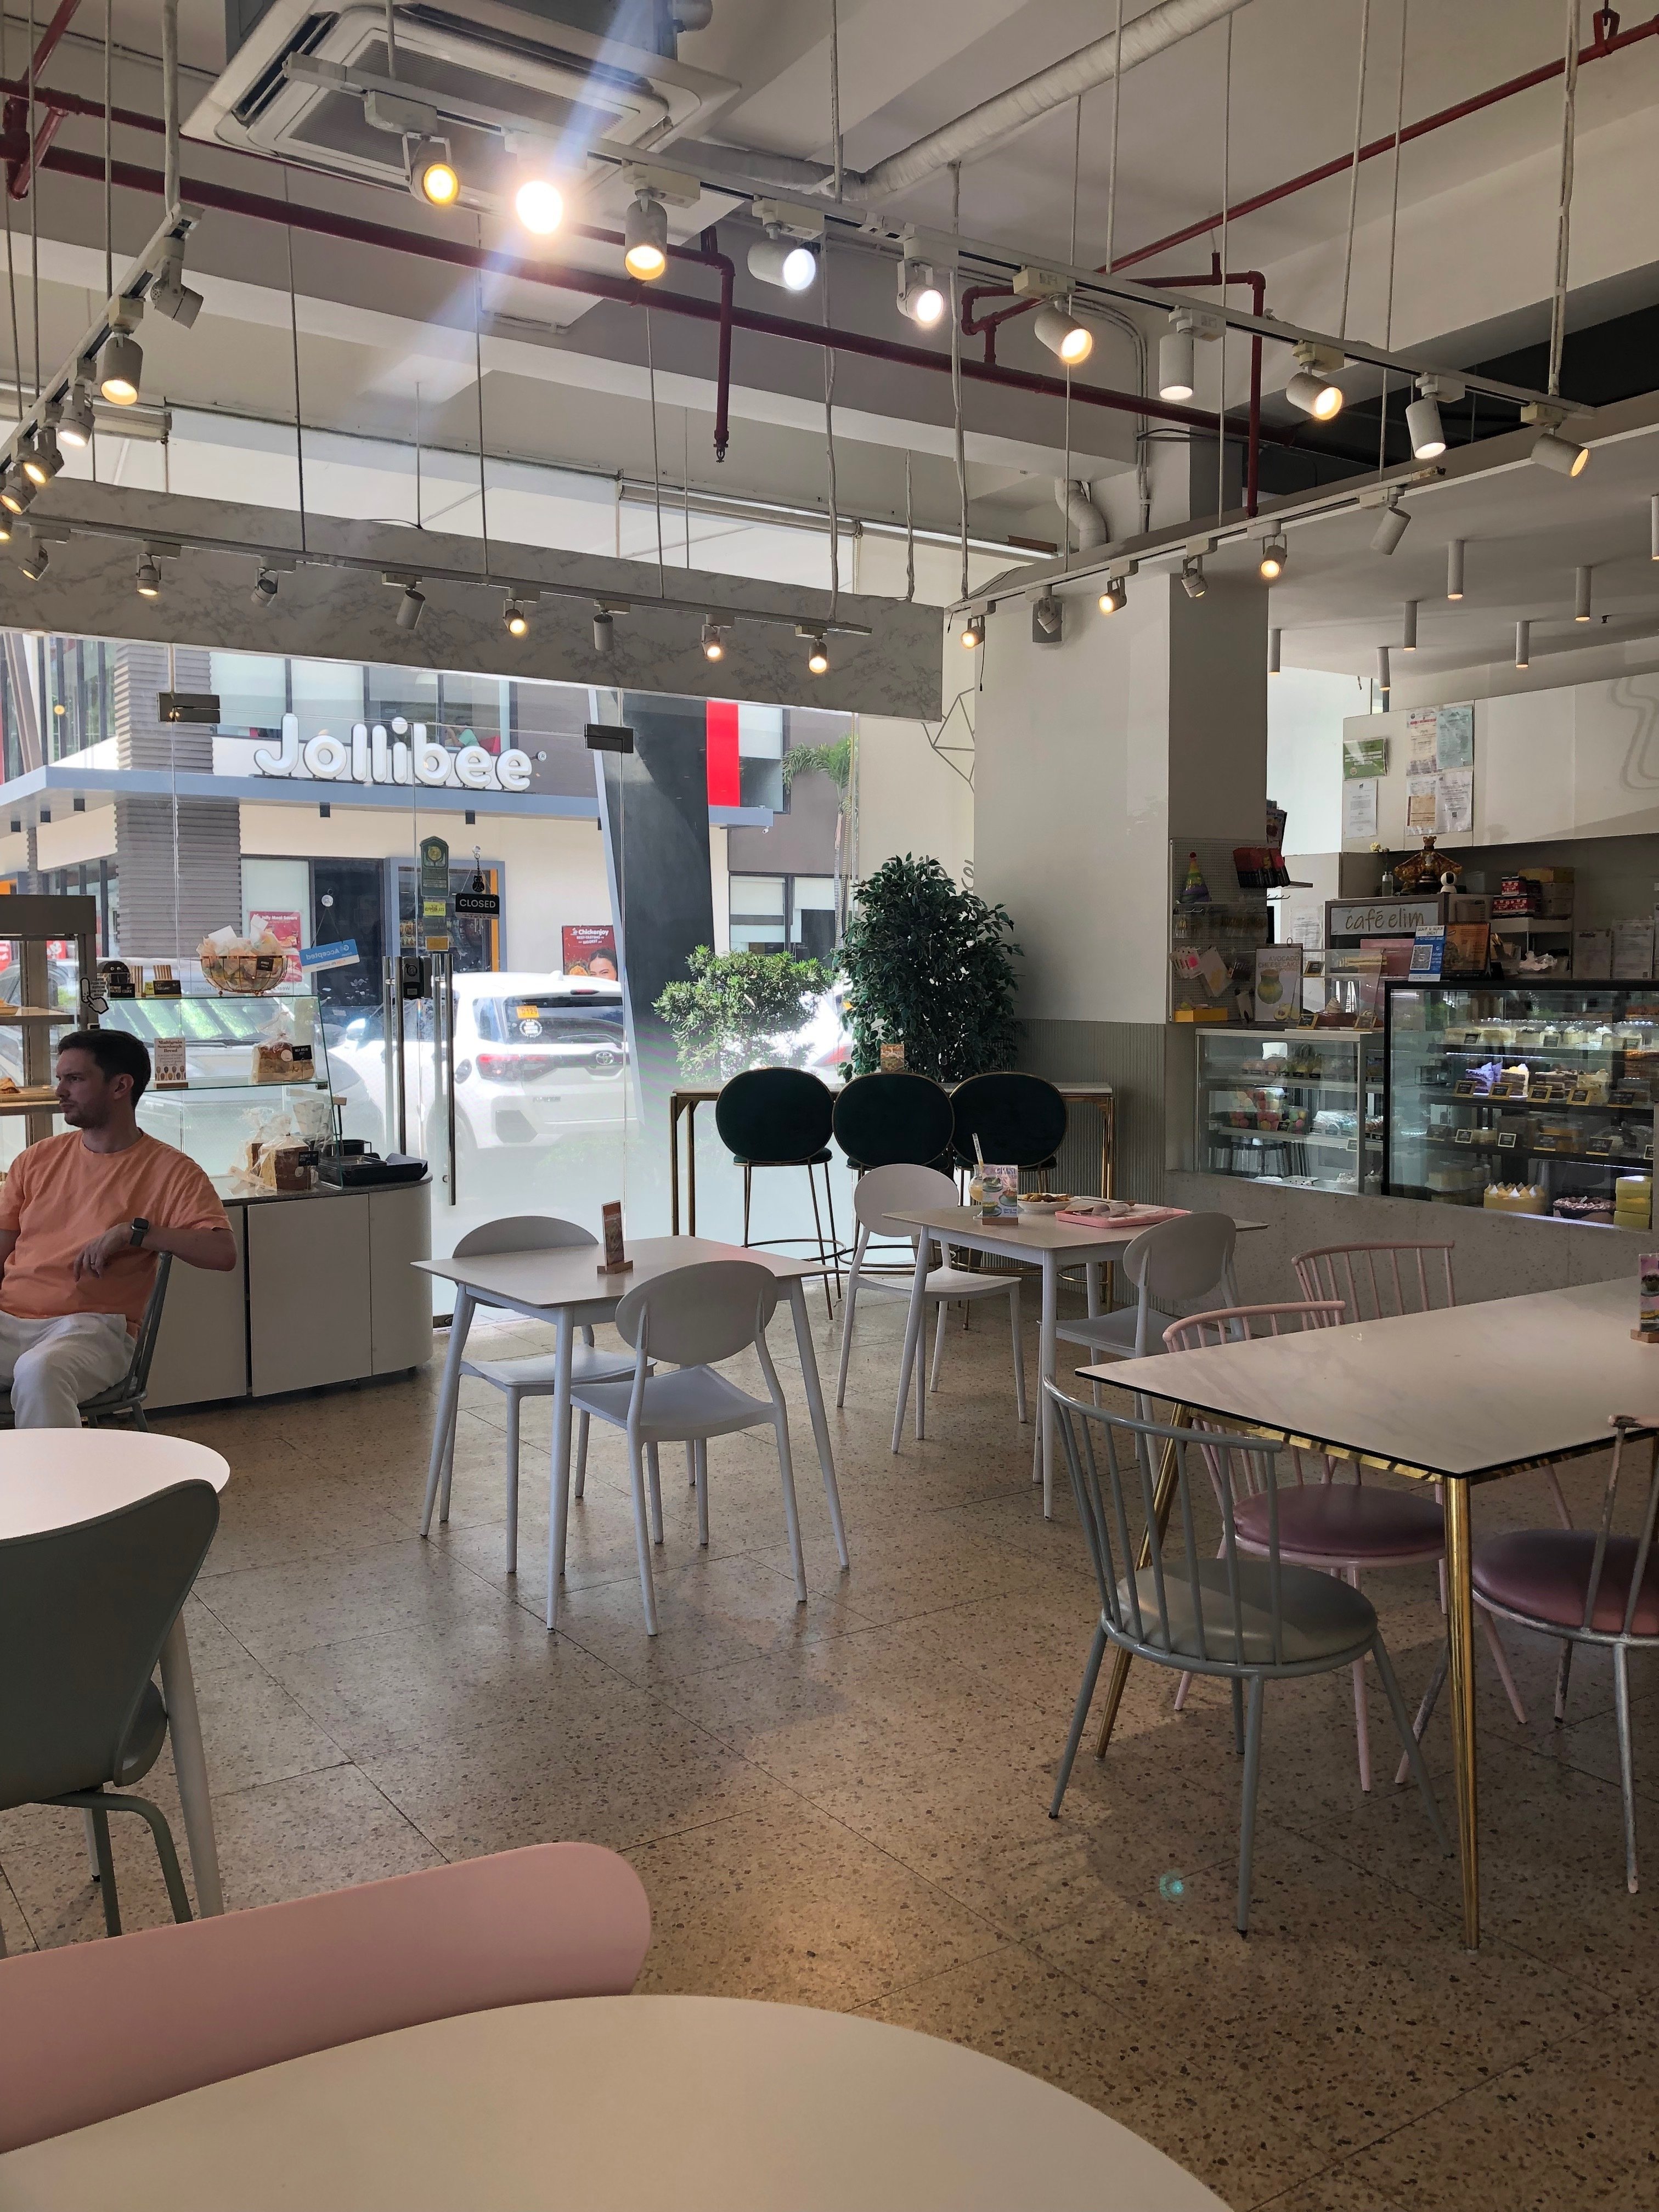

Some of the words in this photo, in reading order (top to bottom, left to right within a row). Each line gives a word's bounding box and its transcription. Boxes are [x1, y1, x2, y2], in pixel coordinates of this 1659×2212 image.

[253, 713, 532, 791] Jollibee
[459, 899, 496, 908] CLOSED
[1388, 907, 1424, 928] elim
